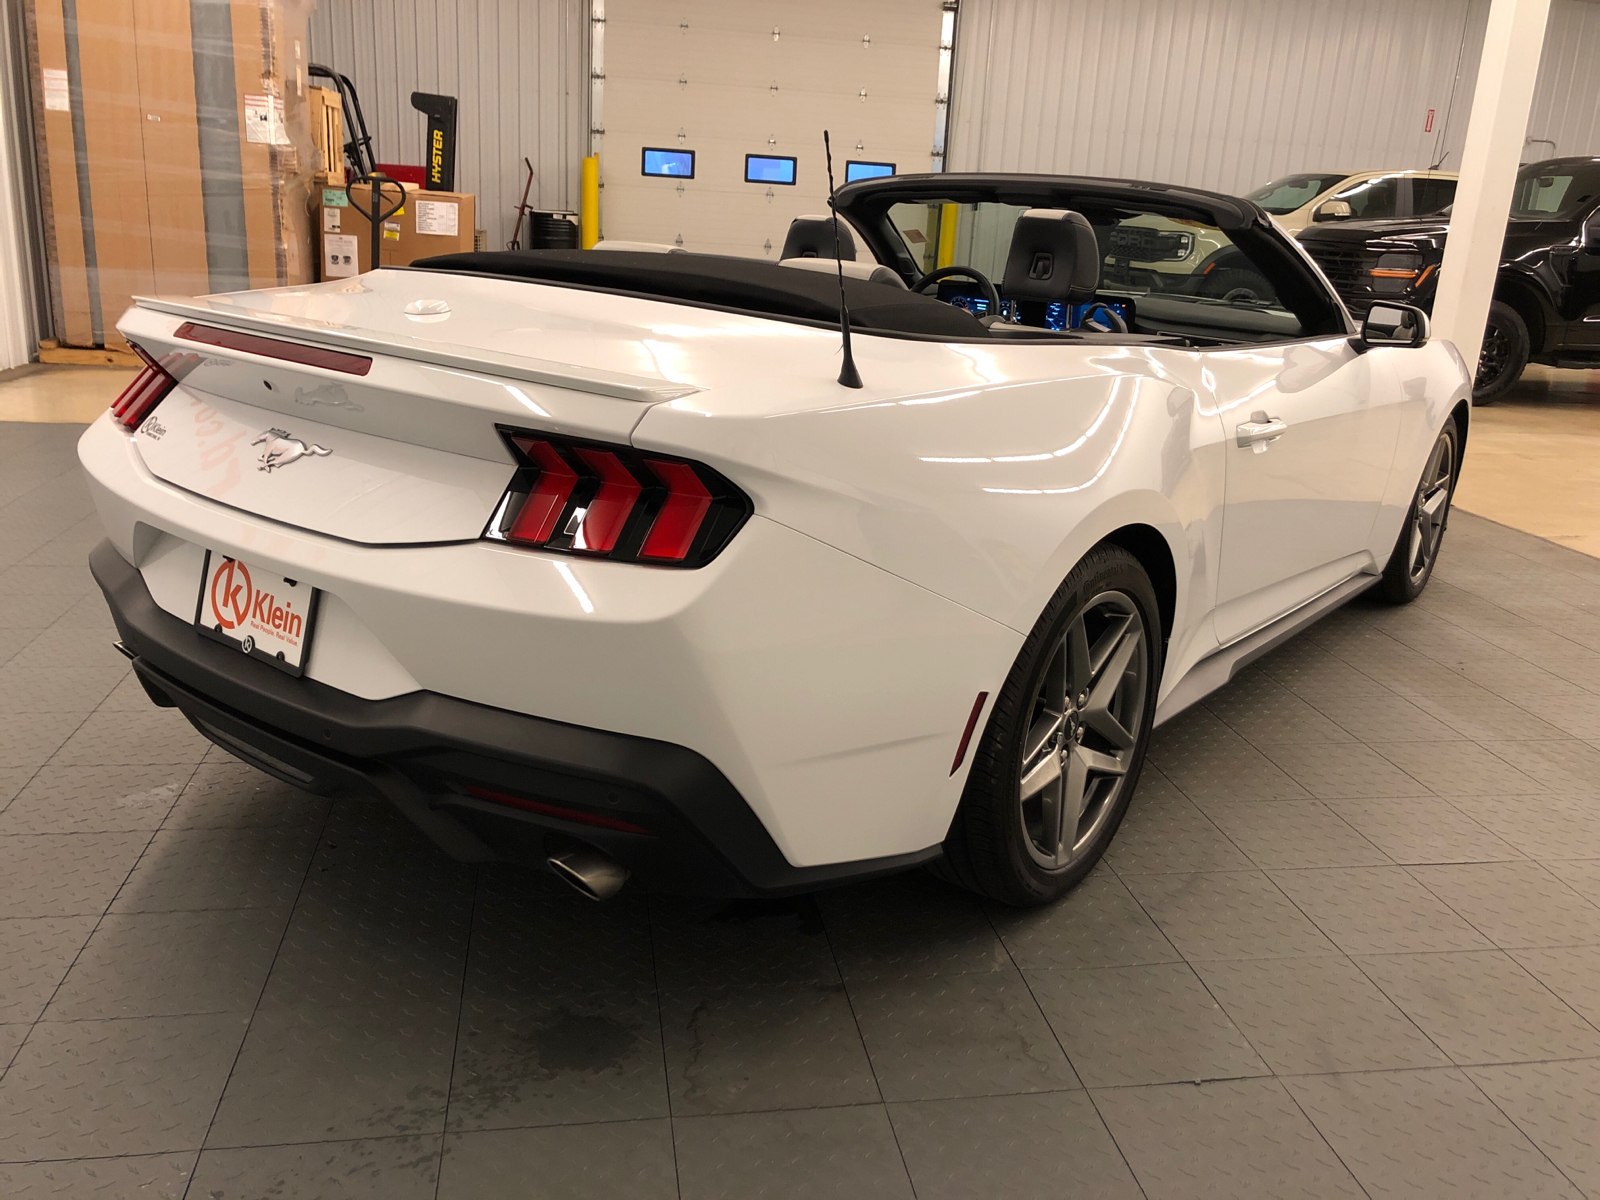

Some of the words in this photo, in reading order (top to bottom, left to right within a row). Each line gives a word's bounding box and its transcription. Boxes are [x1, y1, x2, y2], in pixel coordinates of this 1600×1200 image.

[431, 129, 443, 184] HYSTER
[250, 620, 260, 630] Real
[259, 624, 275, 637] People.
[275, 631, 286, 641] Real
[286, 636, 298, 647] Value.
[252, 589, 302, 638] Klein
